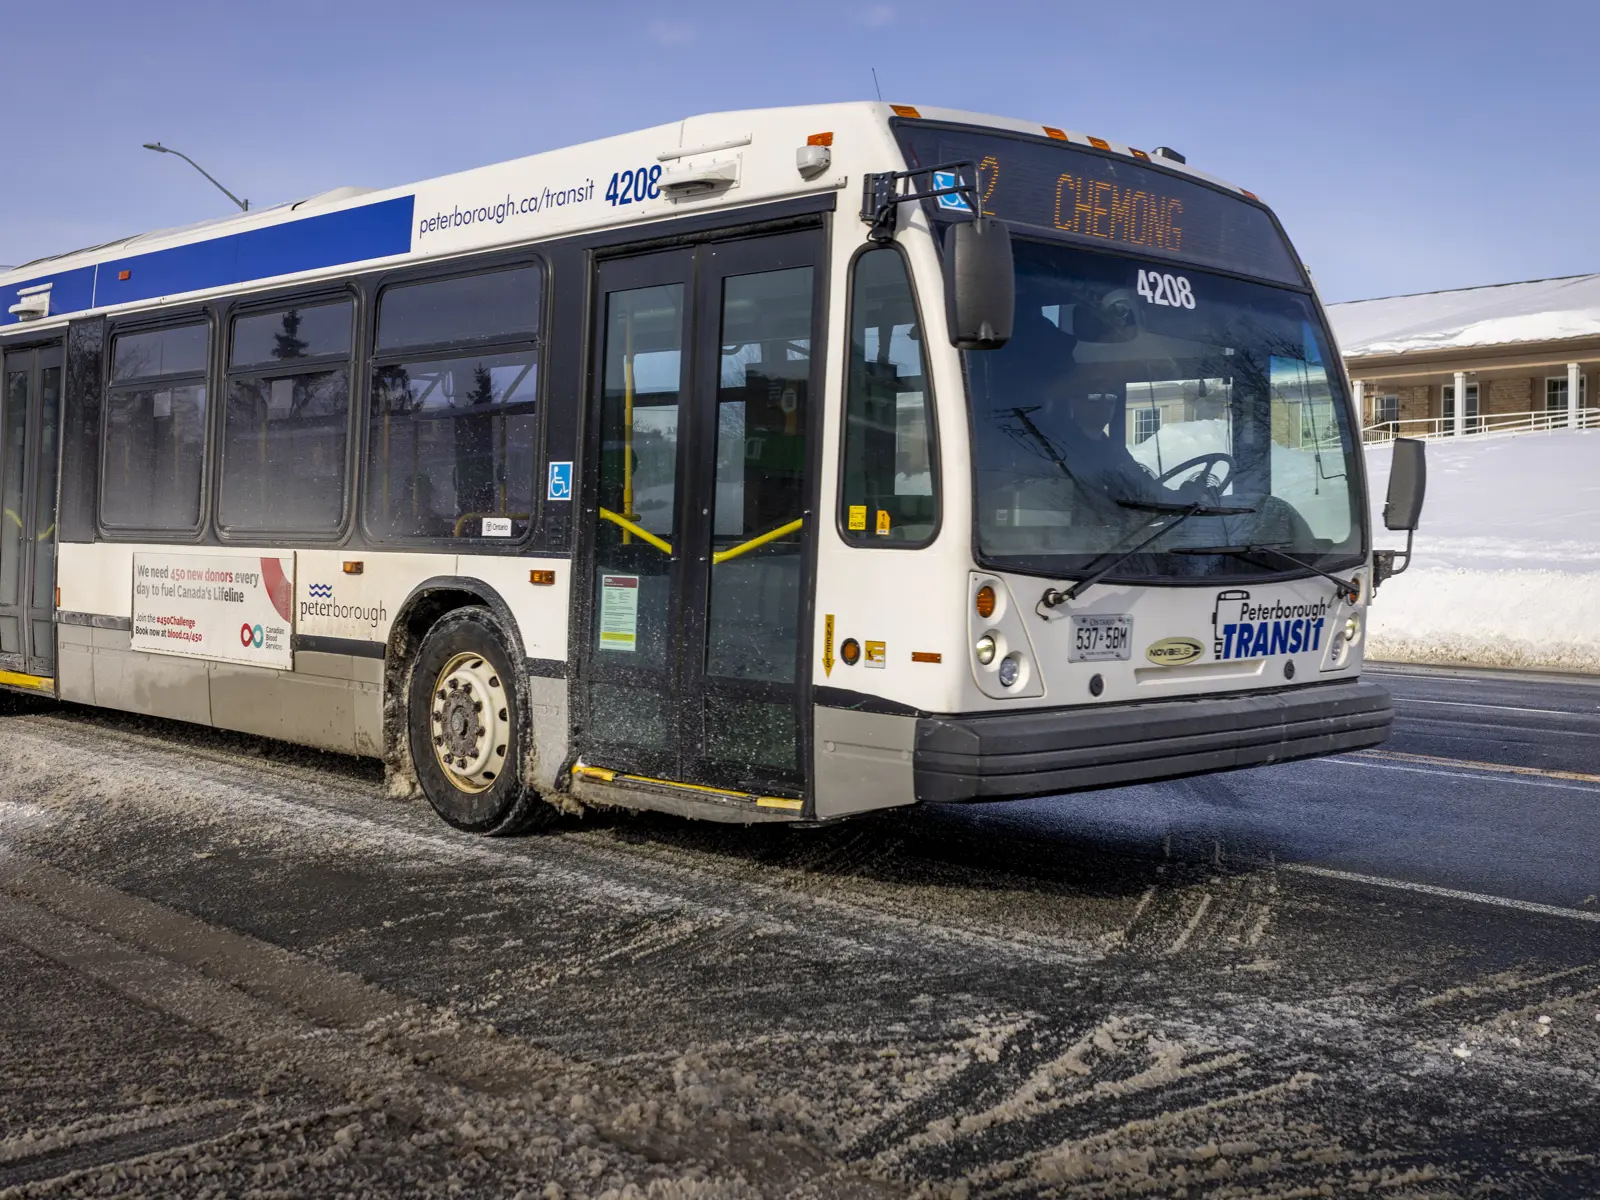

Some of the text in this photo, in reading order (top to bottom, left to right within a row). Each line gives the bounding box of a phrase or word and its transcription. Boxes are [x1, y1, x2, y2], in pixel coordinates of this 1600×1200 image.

[605, 165, 662, 207] 4208
[980, 155, 999, 216] 2
[419, 178, 595, 239] peterborough.ca/transit
[1054, 173, 1183, 251] CHEMONG
[1137, 269, 1196, 309] 4208
[492, 523, 508, 531] Ontario
[137, 564, 259, 588] We need 450 new donors every
[136, 581, 244, 603] day to fuel Canada's Lifeline
[135, 612, 196, 630] Join the #450Challenge
[300, 597, 387, 628] peterborough
[1240, 596, 1326, 622] Peterborough
[135, 625, 203, 643] Book now at blood.ca/450
[265, 626, 285, 635] Canadian
[265, 633, 278, 642] Blood
[1223, 618, 1324, 660] TRANSIT
[265, 641, 283, 651] Services
